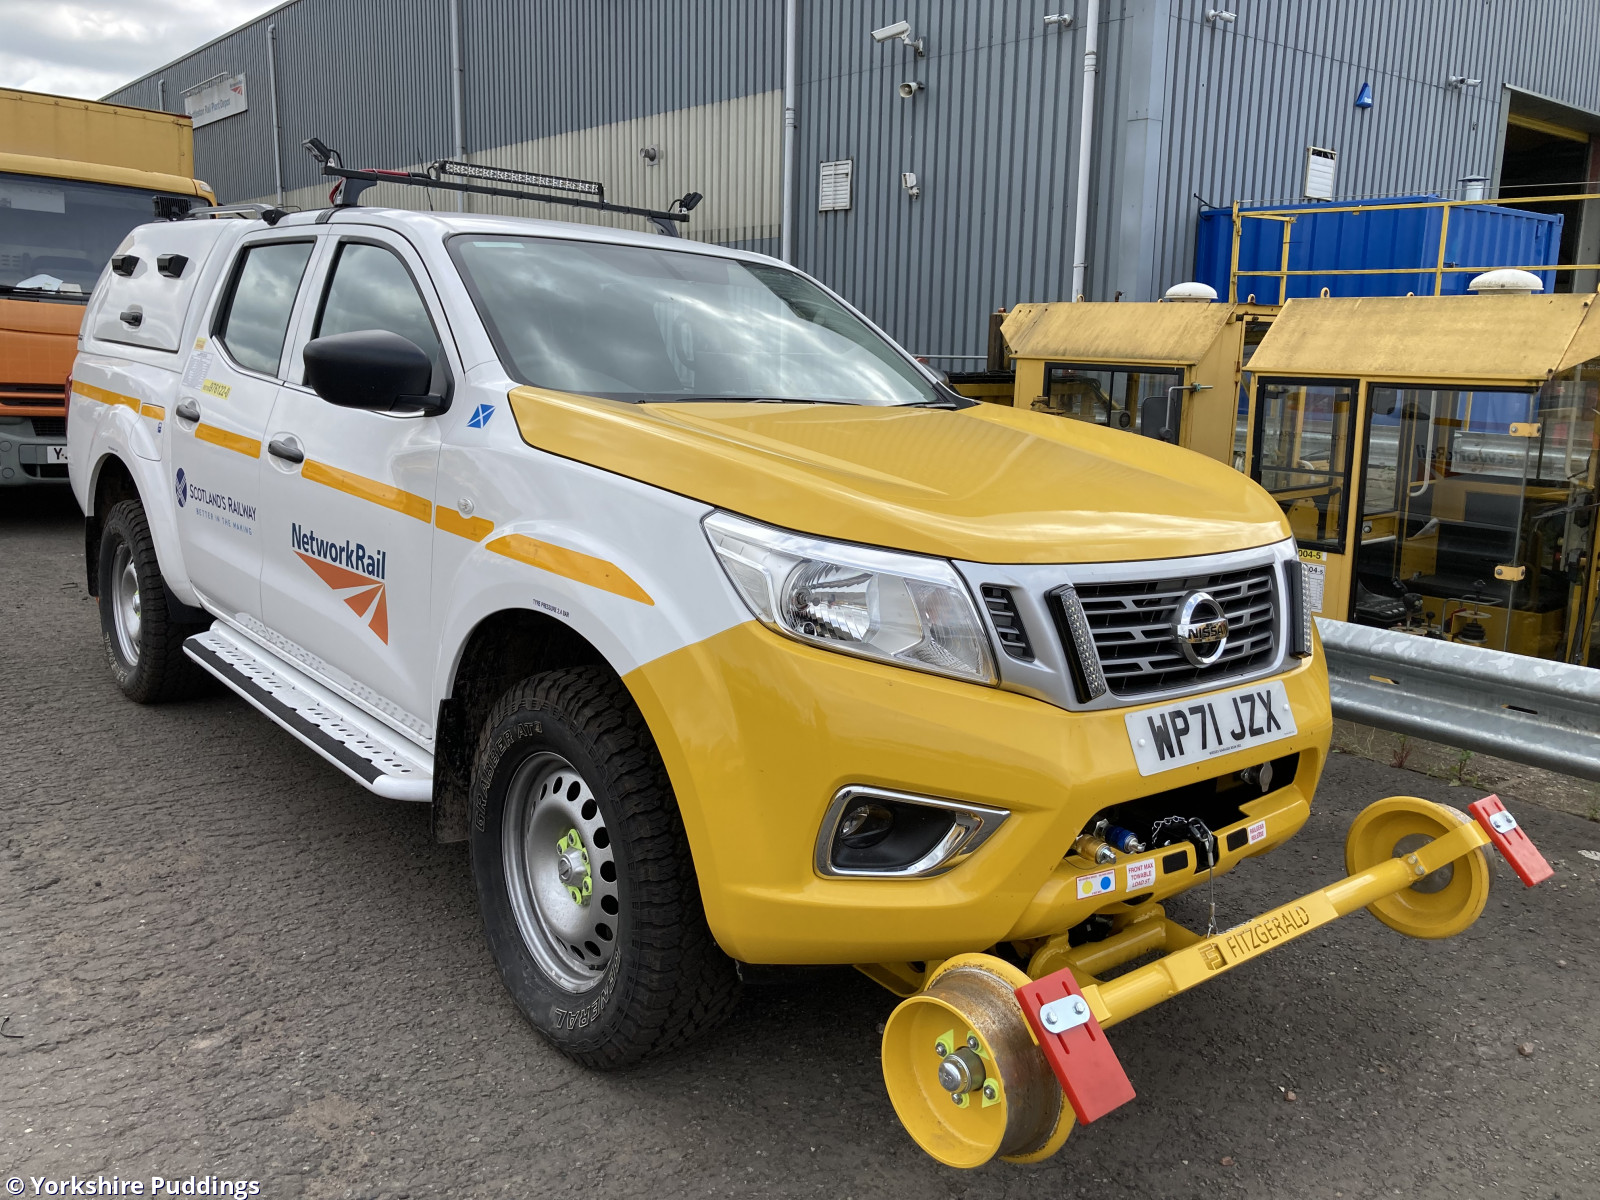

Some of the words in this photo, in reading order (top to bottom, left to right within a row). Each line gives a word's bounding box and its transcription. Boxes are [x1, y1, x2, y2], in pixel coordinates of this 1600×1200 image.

[189, 484, 227, 510] SCOTLAND'S
[228, 497, 257, 521] RAILWAY
[195, 508, 214, 520] BETTER
[222, 517, 231, 527] THE
[233, 522, 253, 535] MAKING
[291, 522, 386, 580] NetworkRail
[1147, 703, 1223, 761] WP71
[1230, 690, 1282, 741] JZX
[475, 729, 515, 832] GRABBER
[1128, 865, 1143, 874] FRONT
[1131, 871, 1152, 880] TOWABLE
[1132, 880, 1144, 888] LOAD
[1226, 905, 1310, 958] FITZGERALD
[555, 946, 621, 1030] GENERAL
